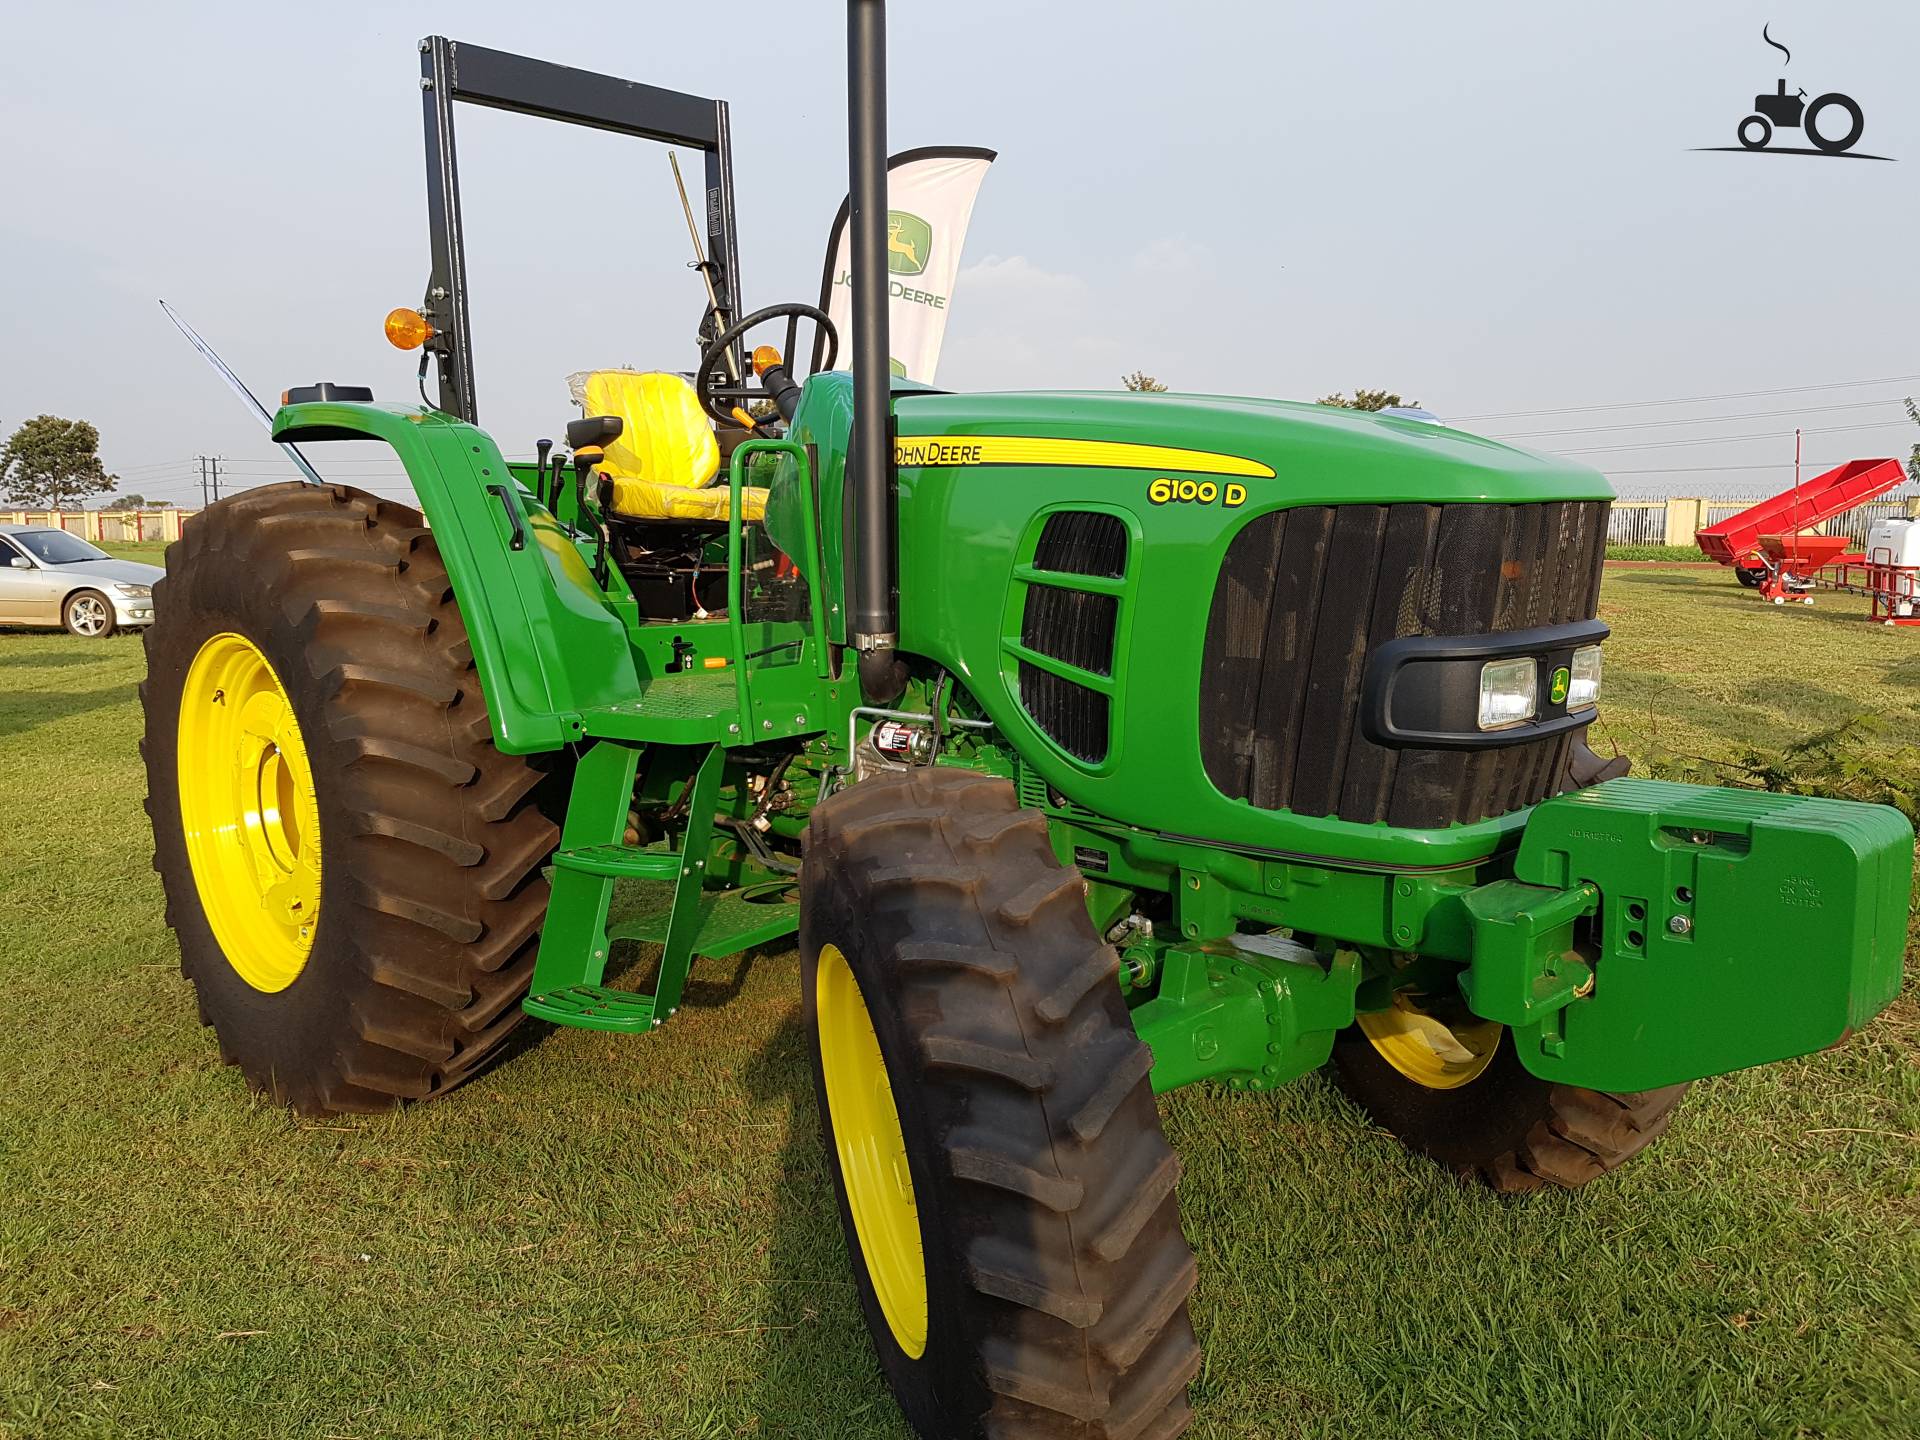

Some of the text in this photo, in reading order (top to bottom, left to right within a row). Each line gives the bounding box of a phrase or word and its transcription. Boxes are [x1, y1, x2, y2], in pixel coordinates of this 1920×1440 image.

[889, 280, 946, 310] DEERE
[895, 442, 982, 462] OHN DEERE
[1147, 477, 1248, 508] 6100 D
